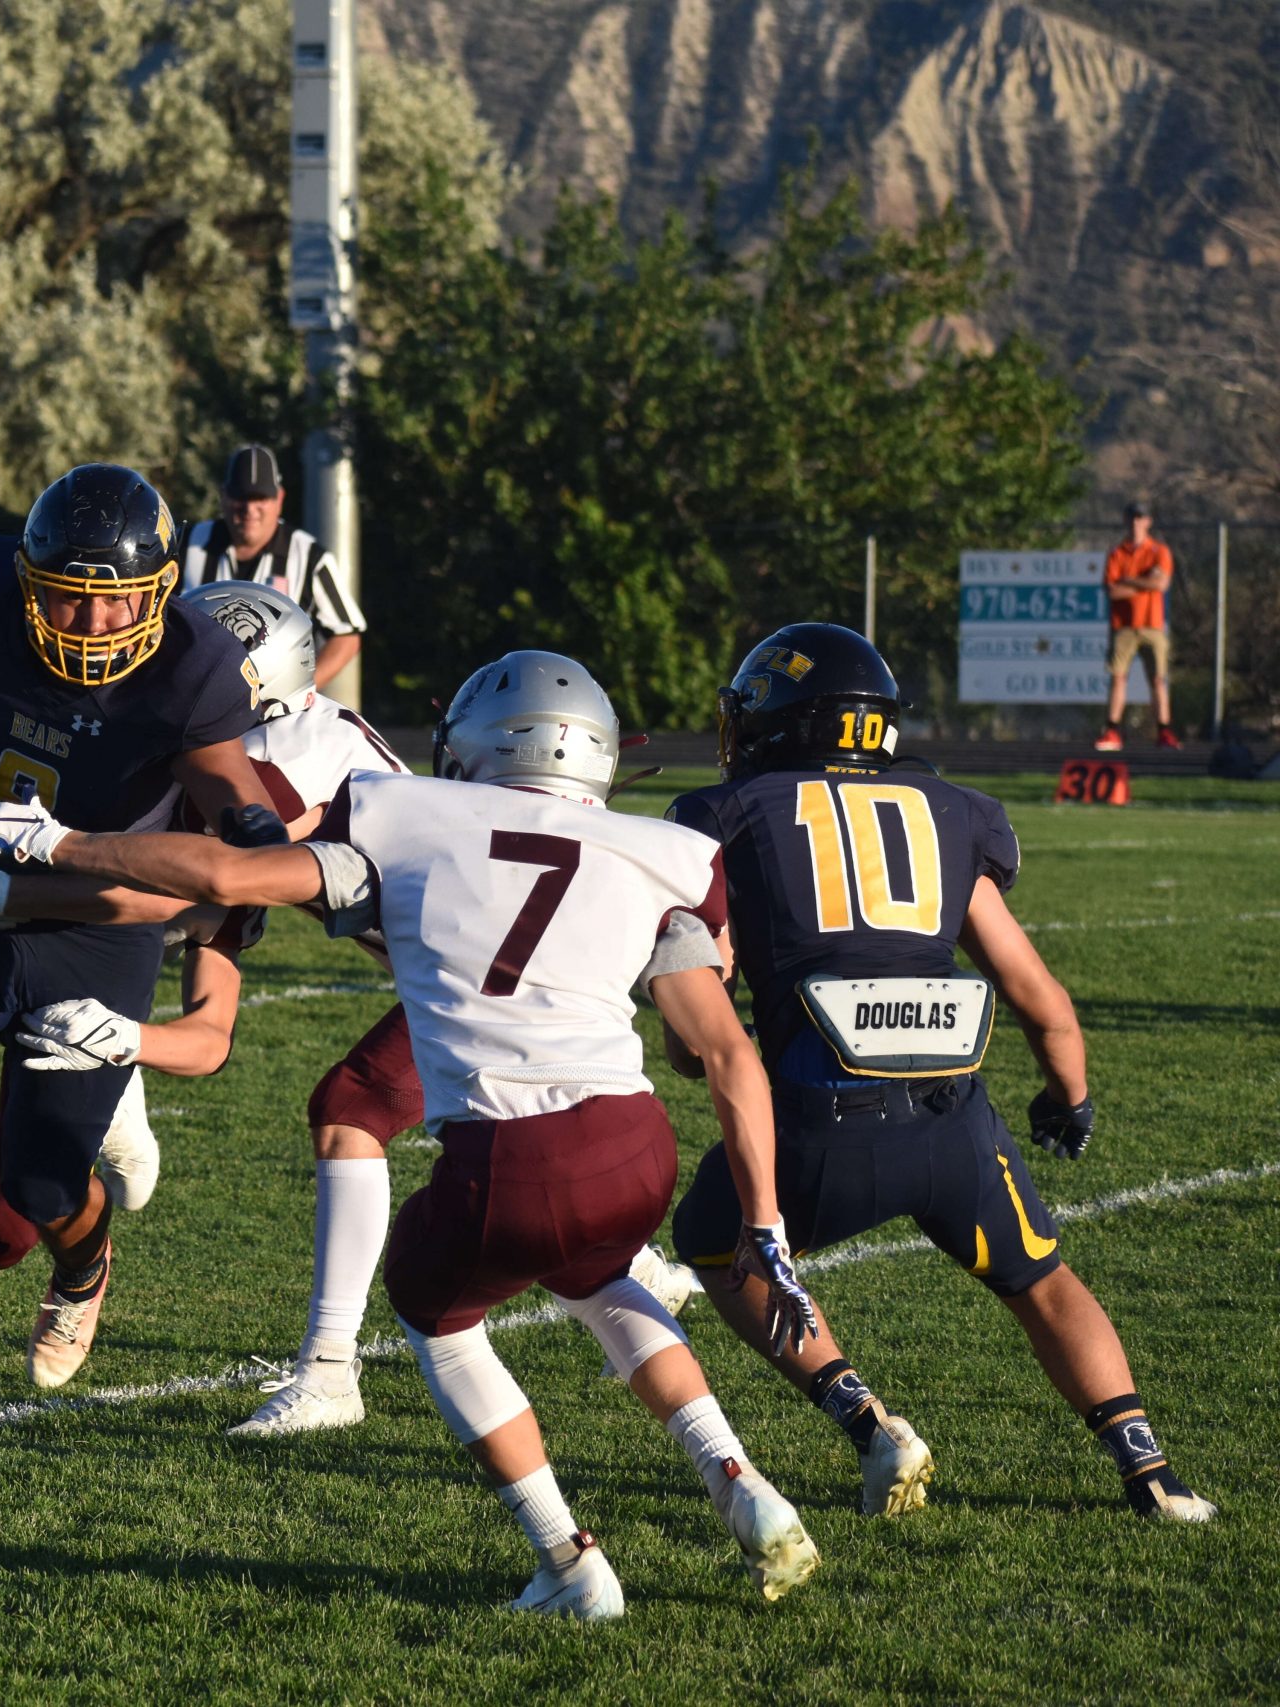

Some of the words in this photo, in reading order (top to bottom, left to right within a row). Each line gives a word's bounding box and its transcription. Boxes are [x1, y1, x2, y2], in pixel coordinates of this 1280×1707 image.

[1031, 559, 1075, 576] SELL
[966, 587, 1106, 619] 970-625-1
[749, 647, 814, 682] FLE
[1005, 674, 1038, 694] GO
[10, 711, 73, 759] BEARS
[559, 723, 568, 741] 7
[838, 712, 883, 750] 10
[1063, 765, 1116, 802] 30
[795, 780, 942, 936] 10
[480, 829, 582, 997] 7
[854, 1001, 957, 1031] DOUGLAS
